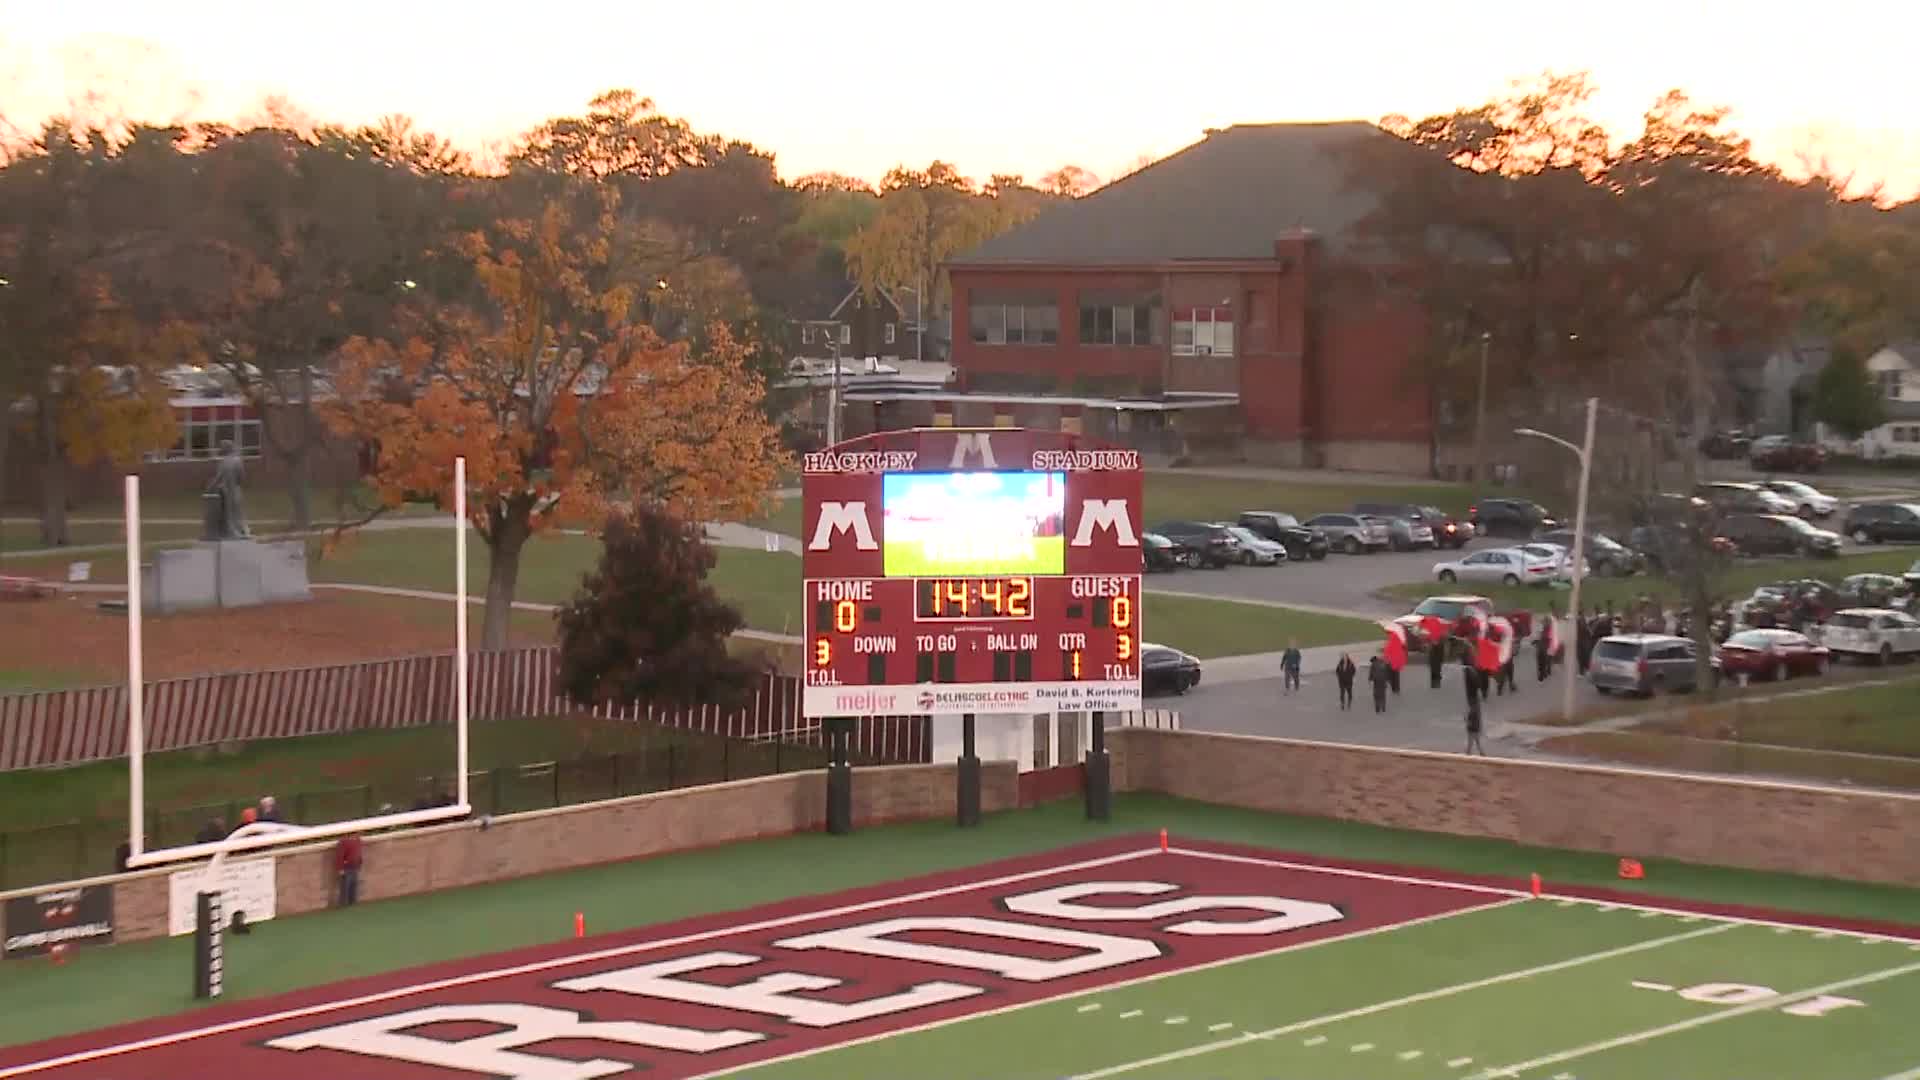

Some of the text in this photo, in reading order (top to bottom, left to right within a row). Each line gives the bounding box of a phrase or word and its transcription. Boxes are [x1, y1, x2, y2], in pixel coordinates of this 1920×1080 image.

[951, 433, 998, 468] M
[1033, 451, 1138, 470] STADIUM
[804, 452, 918, 471] HACKLEY
[808, 502, 879, 550] M
[1071, 499, 1139, 547] M
[817, 581, 873, 601] HOME
[933, 579, 1029, 616] 14:42
[1071, 577, 1132, 598] GUEST
[837, 601, 856, 633] 0
[1112, 597, 1131, 628] 0
[816, 639, 831, 665] 3
[854, 637, 896, 653] DOWN
[916, 635, 957, 652] TO GO
[987, 634, 1038, 650] BALL ON
[1059, 634, 1086, 649] QTR
[1117, 635, 1131, 660] 3
[1072, 651, 1082, 680] 1
[1104, 664, 1137, 681] T.O.L.
[808, 670, 842, 686] T.O.L.
[836, 691, 897, 712] meijer
[1036, 688, 1068, 698] David
[1058, 699, 1118, 710] Law Office
[264, 880, 1346, 1080] REDS
